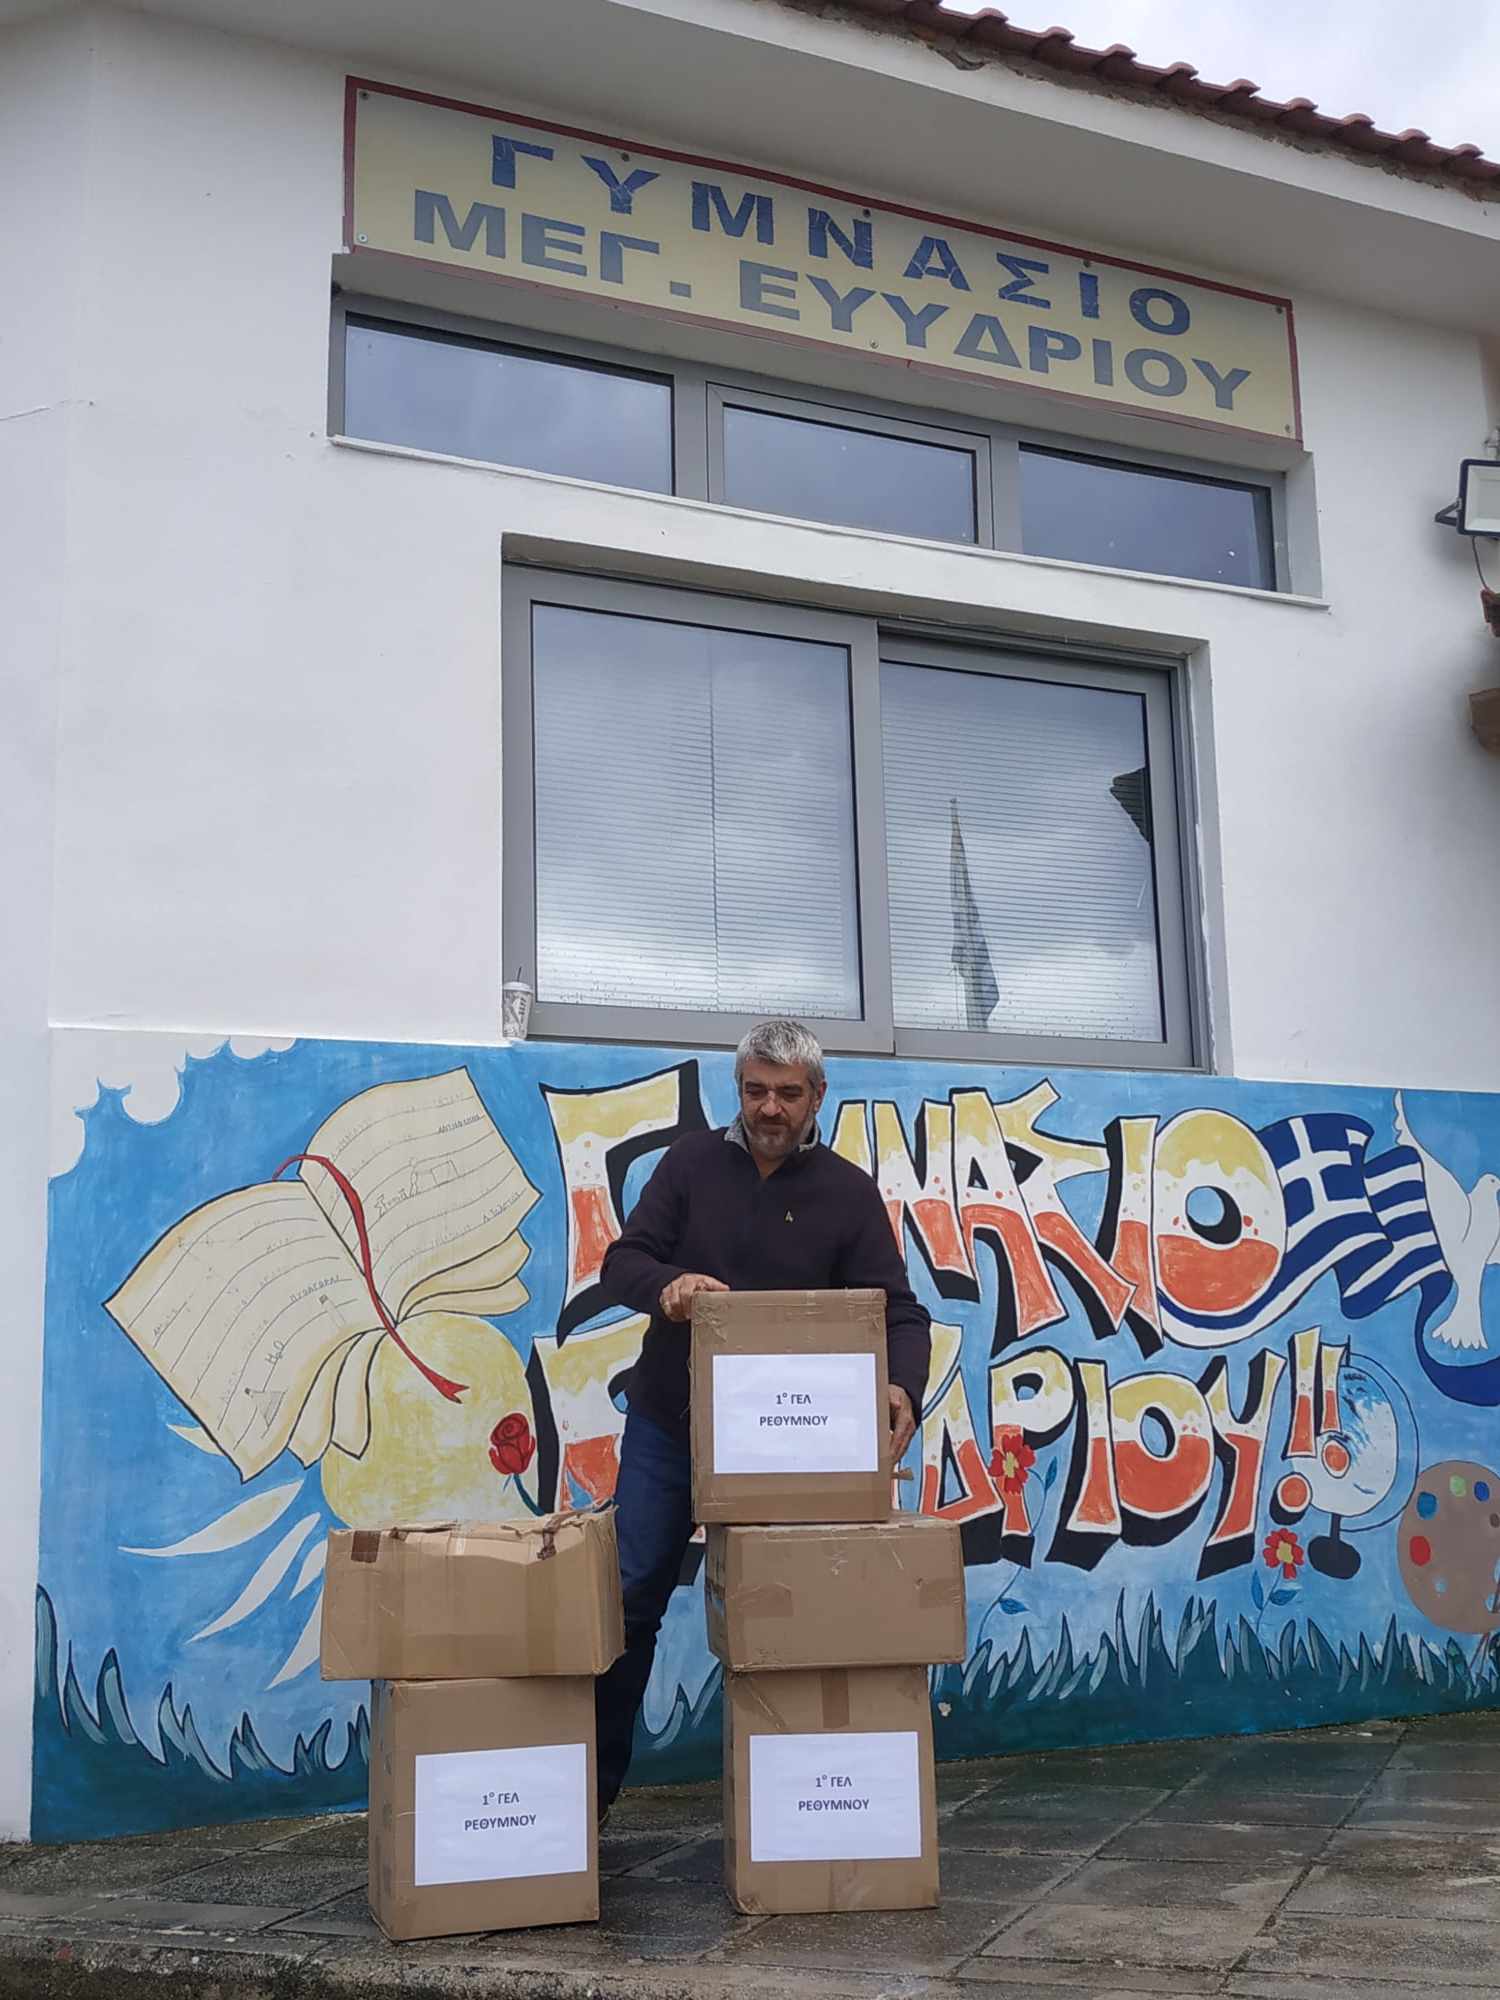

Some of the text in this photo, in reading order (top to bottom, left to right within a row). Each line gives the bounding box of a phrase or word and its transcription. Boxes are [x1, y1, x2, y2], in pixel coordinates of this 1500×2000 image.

[491, 133, 1192, 336] ΓΥΜΝΑΣΙΟ
[413, 189, 1252, 411] ΜΕΓ. ΕΥΥΔΡΙΟΥ
[790, 1393, 812, 1405] ΓΕΛ
[759, 1415, 829, 1427] ΡΕΘΥΜΝΟΥ
[830, 1776, 853, 1788] ΓΕΛ
[497, 1791, 520, 1805] ΓΕΛ
[798, 1798, 870, 1812] ΡΕΘΥΜΝΟΥ
[464, 1814, 537, 1832] ΡΕΘΥΜΝΟΥ
